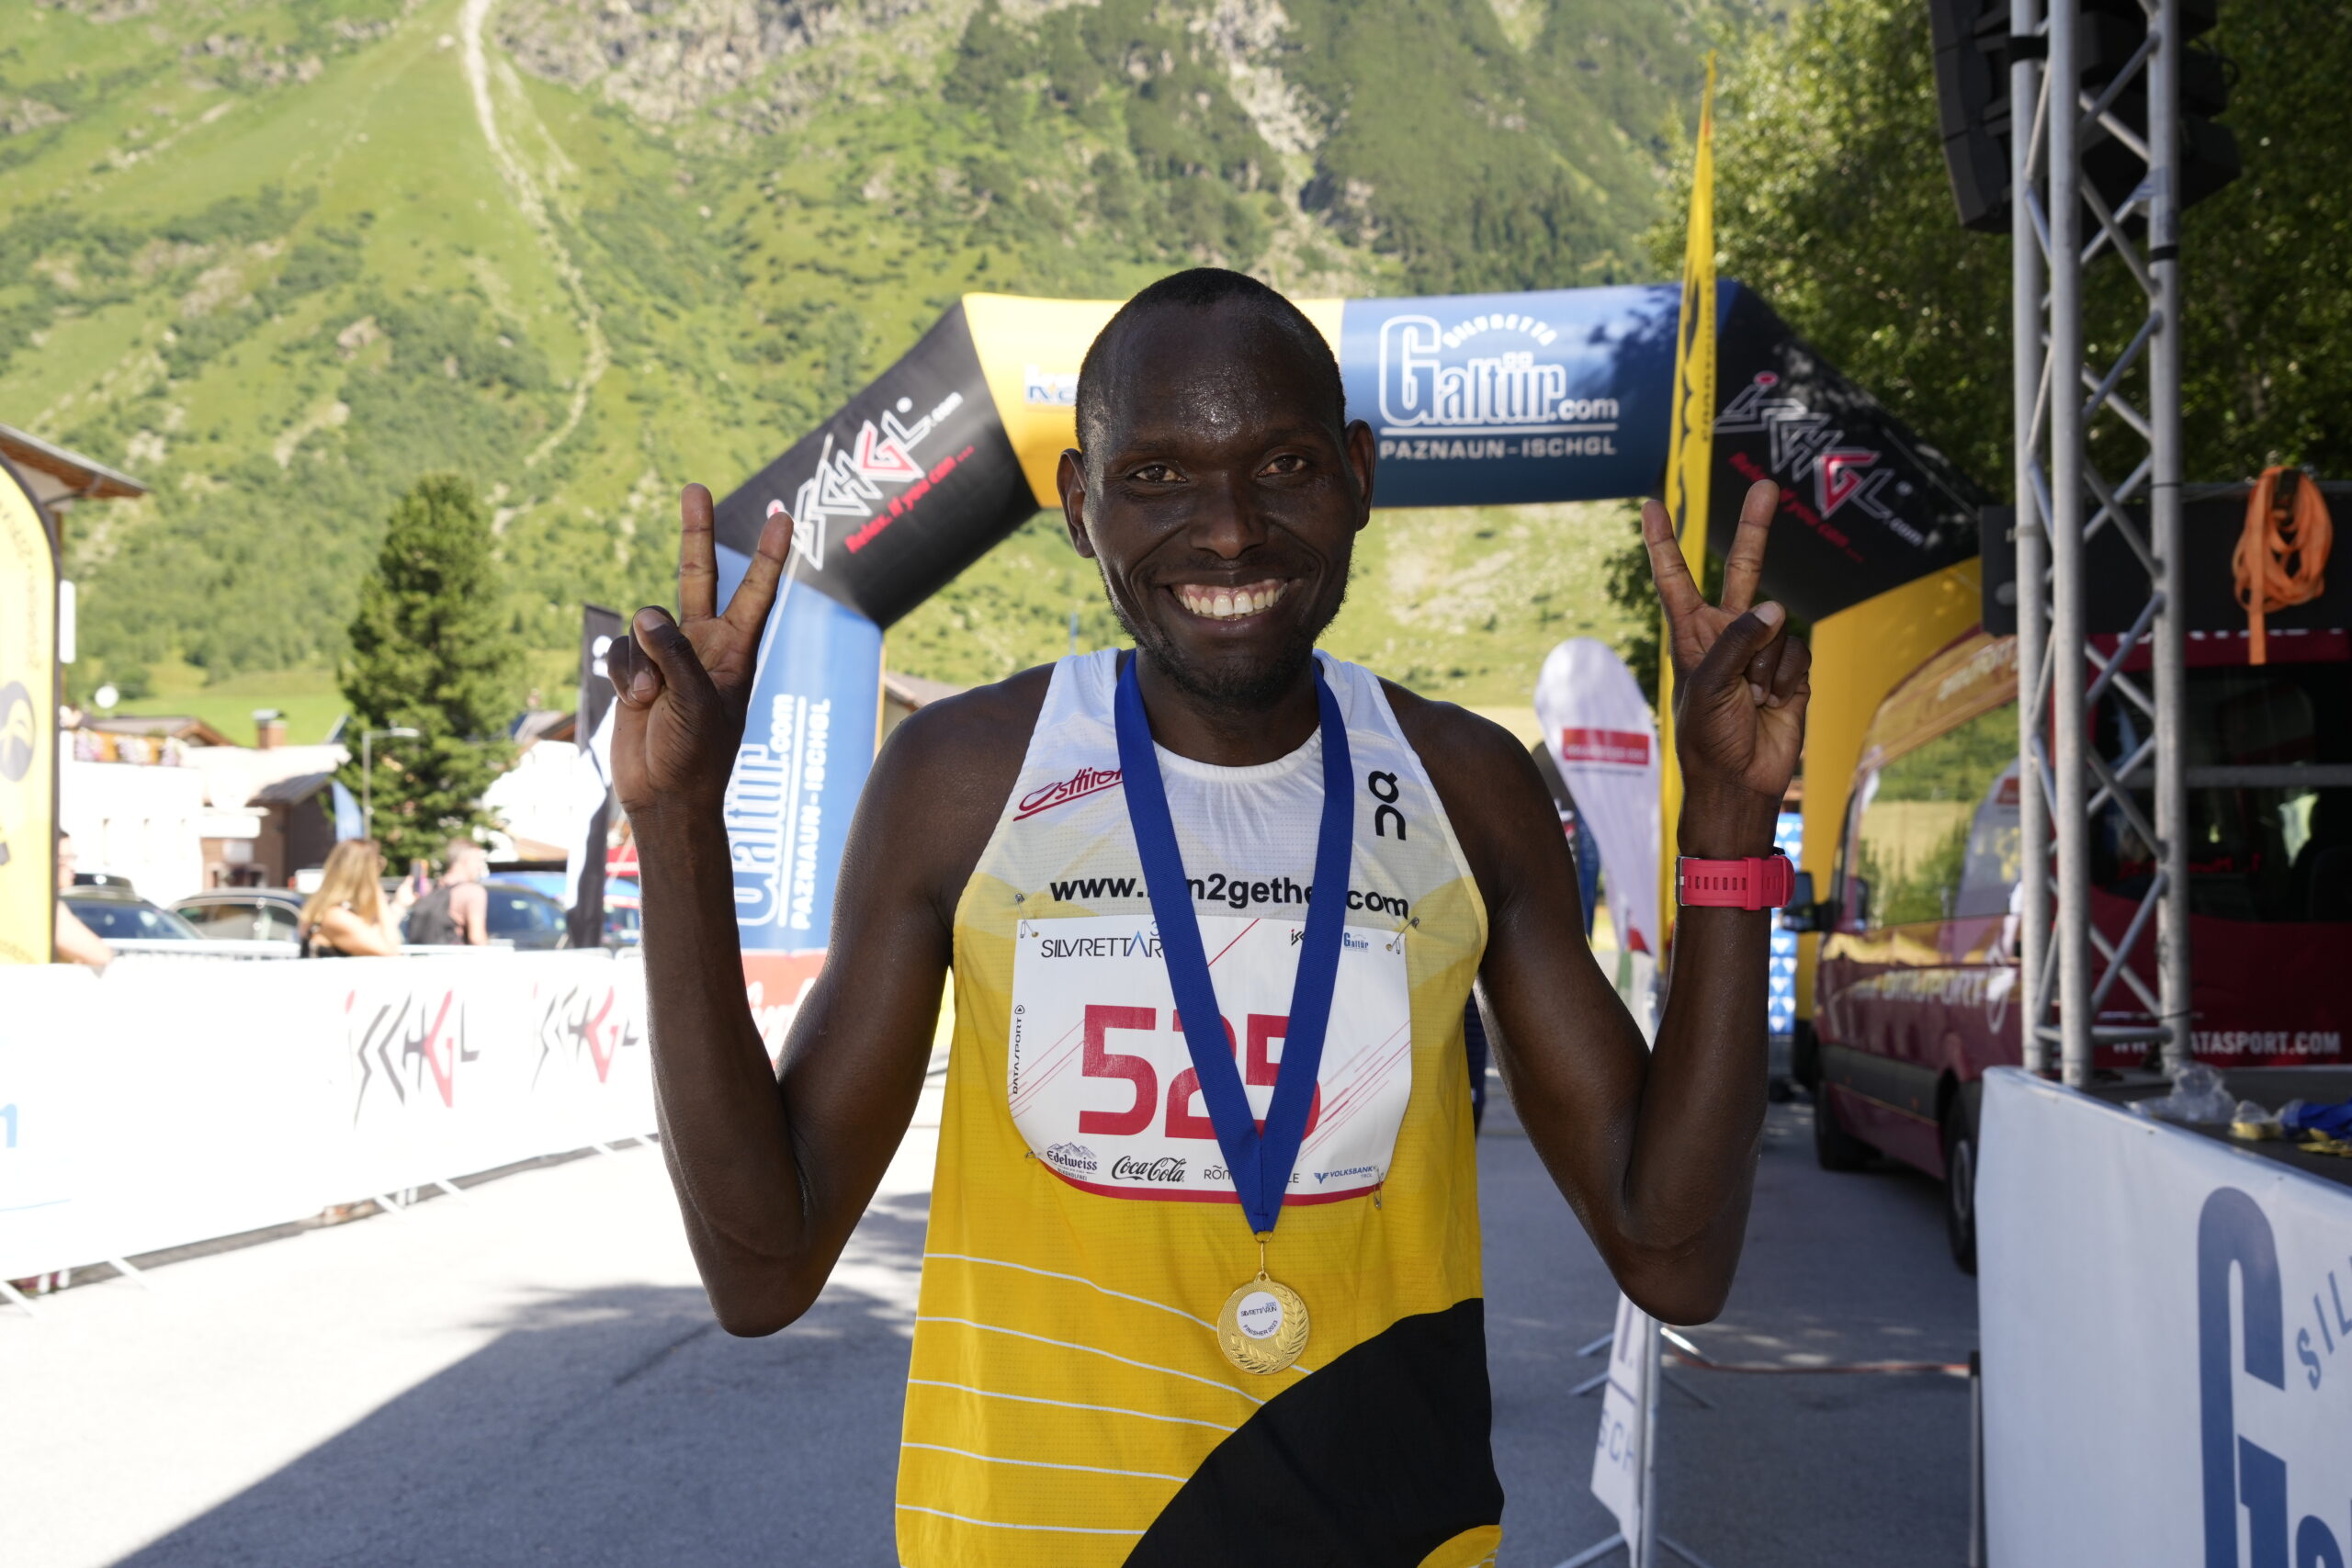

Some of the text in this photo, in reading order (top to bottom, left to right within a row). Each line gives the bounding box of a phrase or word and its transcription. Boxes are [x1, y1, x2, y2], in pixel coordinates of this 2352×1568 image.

[1041, 931, 1163, 958] SILVRETTAR
[2190, 1032, 2341, 1055] ATASPORT.COM
[1079, 1004, 1321, 1142] 525
[1046, 1150, 1098, 1171] Edelweiss
[1111, 1156, 1187, 1183] Coca-Cola
[1329, 1166, 1374, 1178] VOLKSBANK
[1243, 1324, 1268, 1336] FINISHER
[2297, 1255, 2352, 1391] SIL
